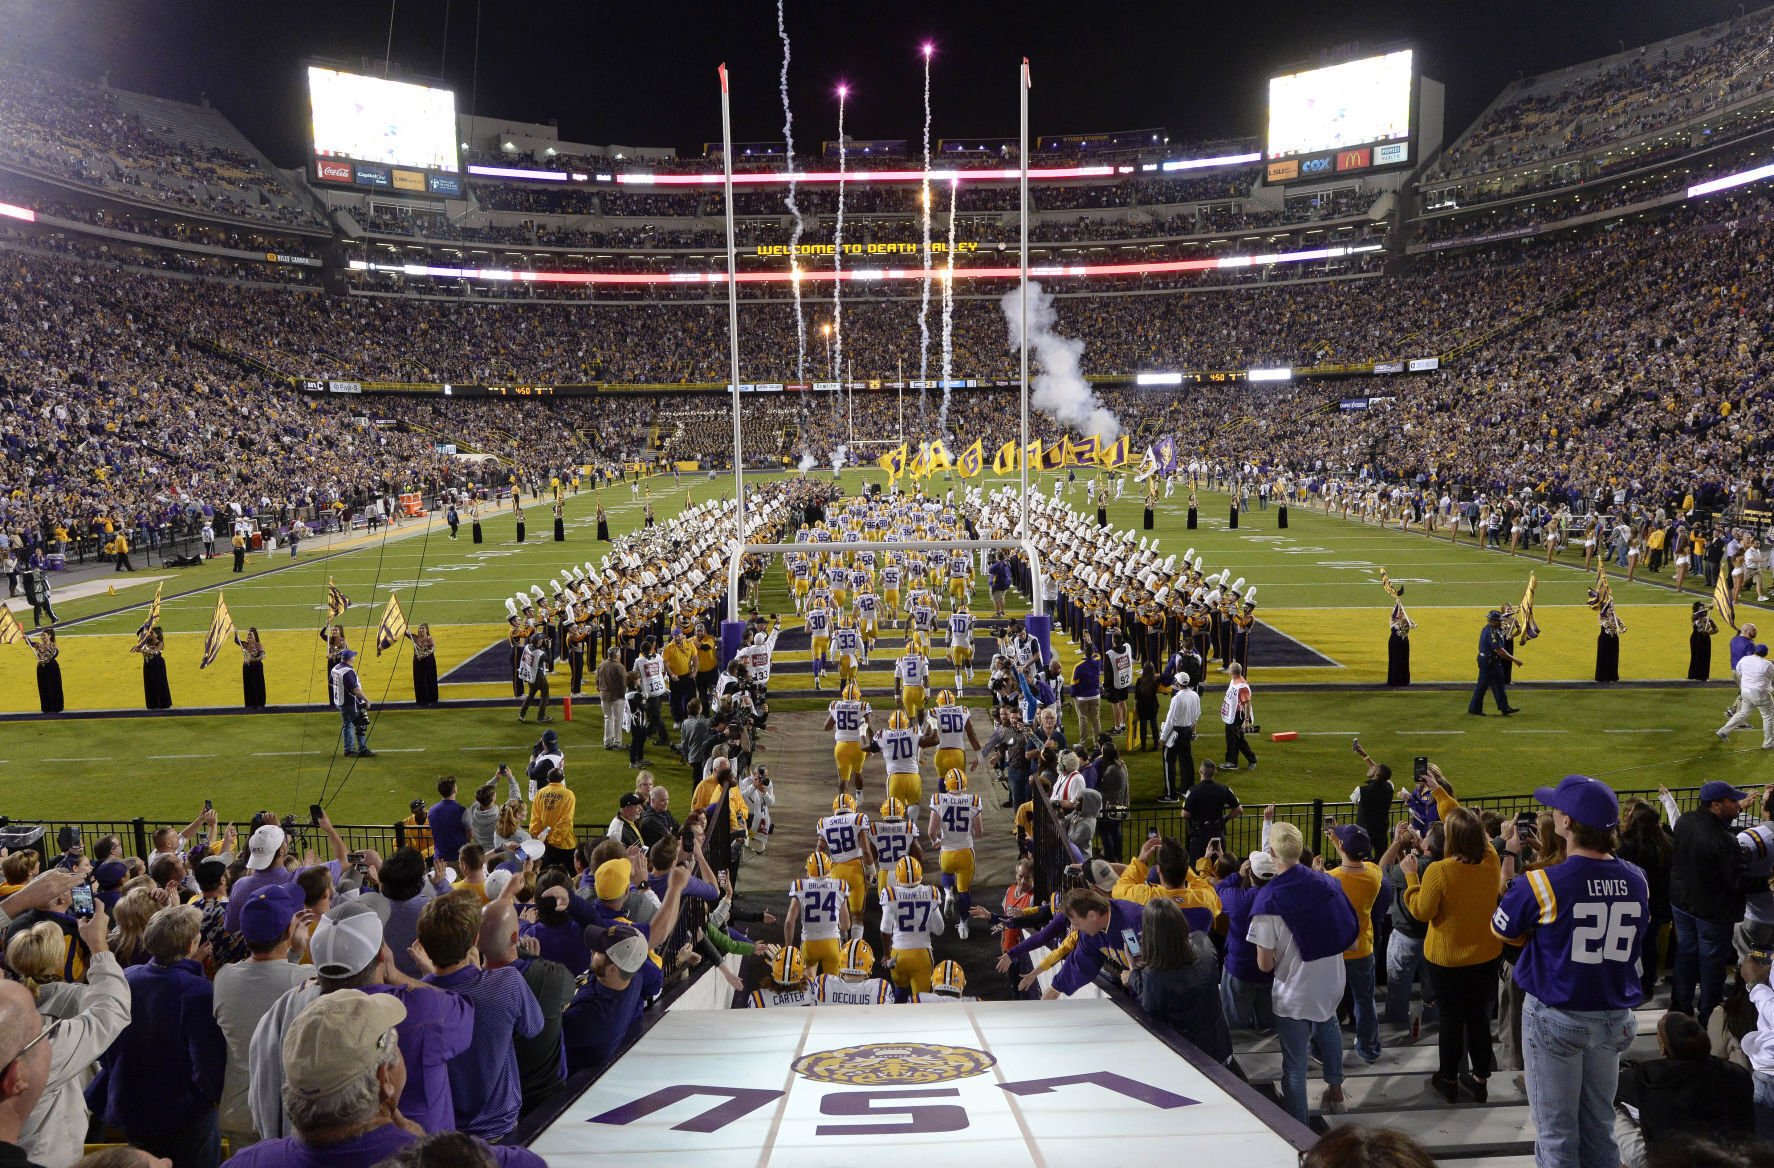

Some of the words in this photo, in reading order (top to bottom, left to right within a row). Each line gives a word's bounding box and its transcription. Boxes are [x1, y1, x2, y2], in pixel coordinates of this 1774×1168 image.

[1302, 157, 1330, 173] COX
[757, 244, 836, 255] WELCOME
[842, 244, 862, 253] TO
[867, 243, 917, 253] DEATH
[862, 554, 873, 566] 58
[933, 554, 944, 564] 45
[796, 565, 807, 576] 29
[912, 564, 921, 575] 41
[954, 561, 965, 572] 97
[832, 570, 844, 582] 79
[853, 575, 865, 588] 48
[886, 572, 898, 583] 55
[860, 597, 874, 611] 42
[810, 615, 825, 630] 30
[916, 611, 928, 625] 31
[953, 619, 966, 633] 10
[839, 634, 855, 649] 33
[907, 661, 917, 677] 2
[650, 680, 664, 692] 135
[837, 710, 858, 731] 85
[941, 713, 963, 733] 90
[887, 736, 913, 761] 70
[830, 817, 848, 826] SMALL
[942, 806, 970, 832] 45
[826, 825, 856, 855] 58
[877, 835, 907, 863] 22
[1587, 879, 1628, 896] LEWIS
[805, 891, 837, 923] 24
[898, 901, 931, 932] 27
[1571, 901, 1641, 965] 26
[773, 991, 805, 1006] CARTER
[832, 992, 870, 1005] DECULUS
